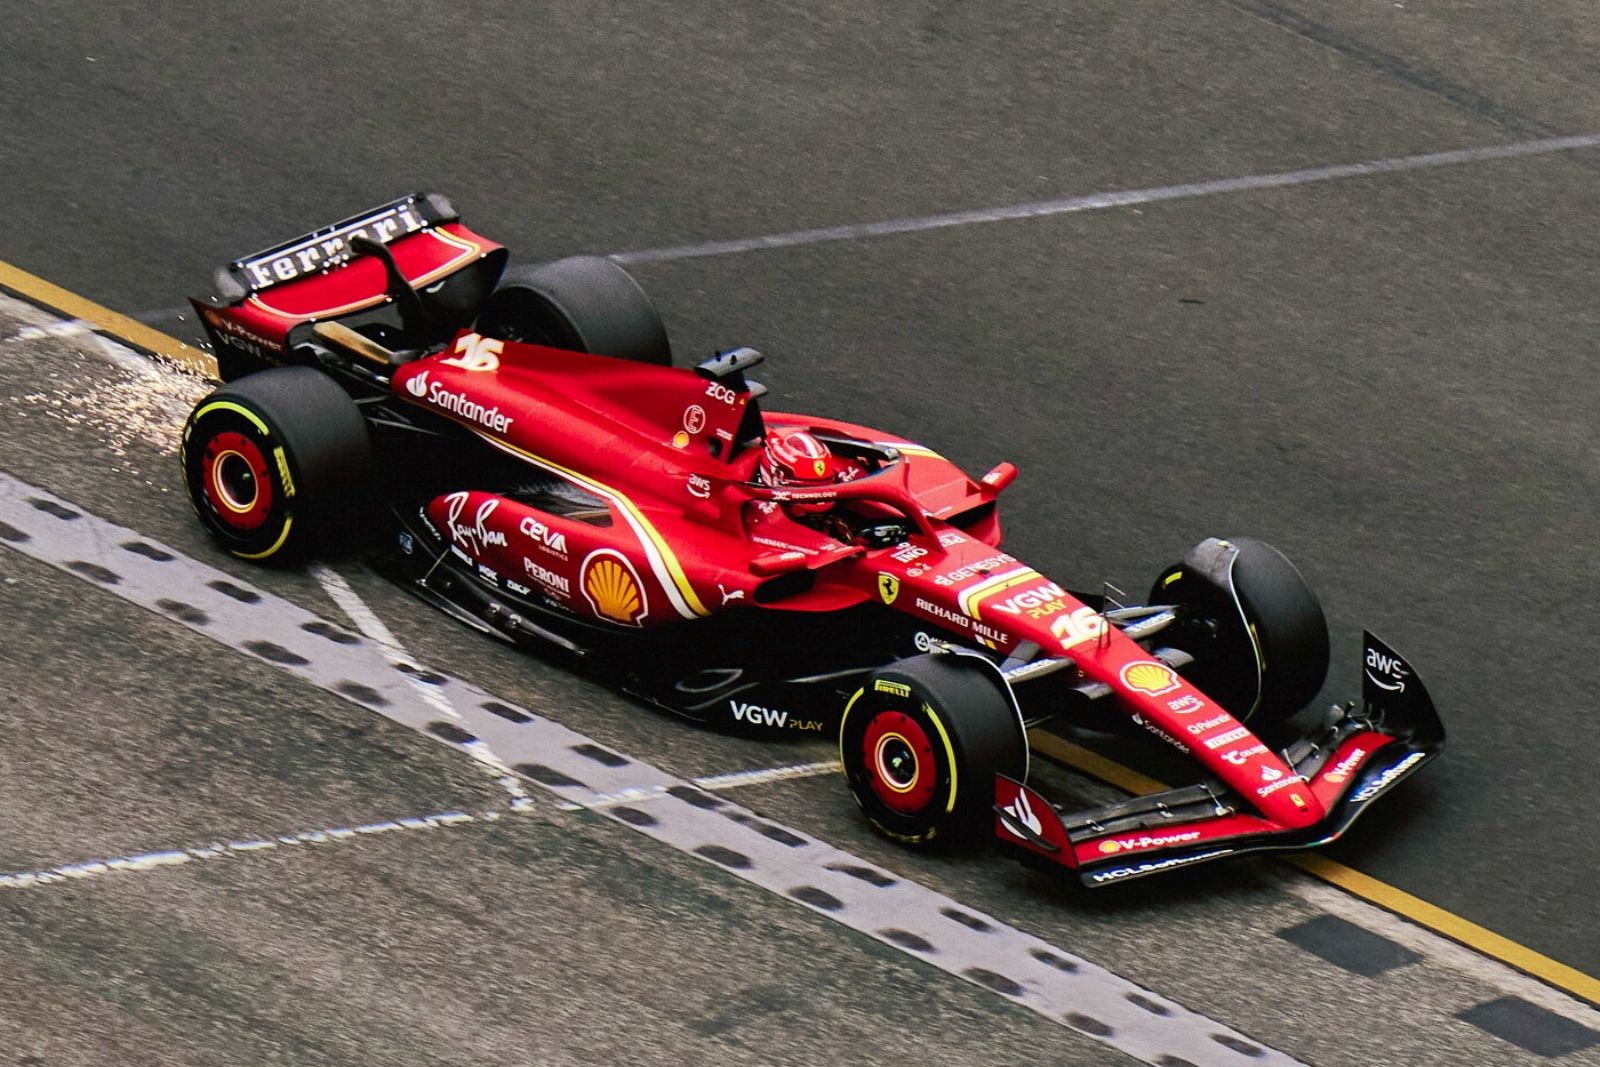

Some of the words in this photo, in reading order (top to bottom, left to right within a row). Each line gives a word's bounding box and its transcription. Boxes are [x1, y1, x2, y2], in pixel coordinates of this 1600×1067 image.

[438, 332, 504, 372] 16
[427, 381, 513, 434] Santander
[705, 381, 736, 405] ZCG
[688, 473, 710, 491] aws
[791, 491, 837, 499] TECHNOLOGY
[523, 556, 570, 593] PERONI
[992, 582, 1067, 615] VGW
[1027, 599, 1068, 620] PLAY
[915, 597, 969, 628] RICHARD
[971, 620, 1009, 645] MILLE
[1049, 605, 1110, 651] 16
[1366, 647, 1408, 679] aws
[729, 699, 789, 729] VGW
[788, 717, 824, 732] PLAY
[1167, 694, 1199, 711] aws
[1118, 830, 1201, 851] V-Power
